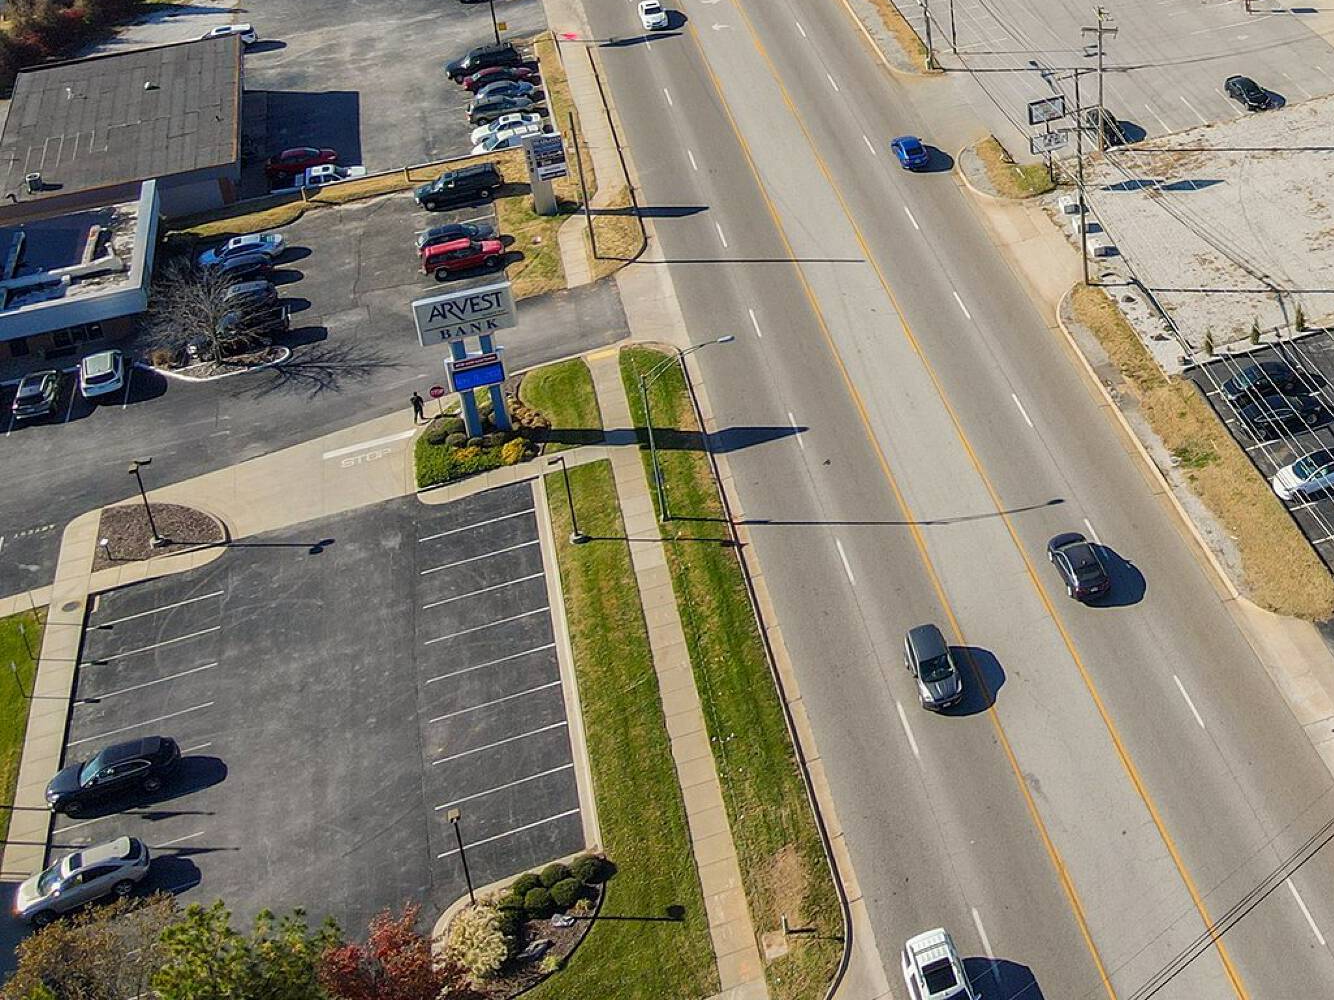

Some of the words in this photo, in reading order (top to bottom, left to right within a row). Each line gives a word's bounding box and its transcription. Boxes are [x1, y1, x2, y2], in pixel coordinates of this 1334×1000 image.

[428, 291, 502, 322] ARVEST
[440, 318, 498, 339] BANK
[341, 448, 391, 468] STOP
